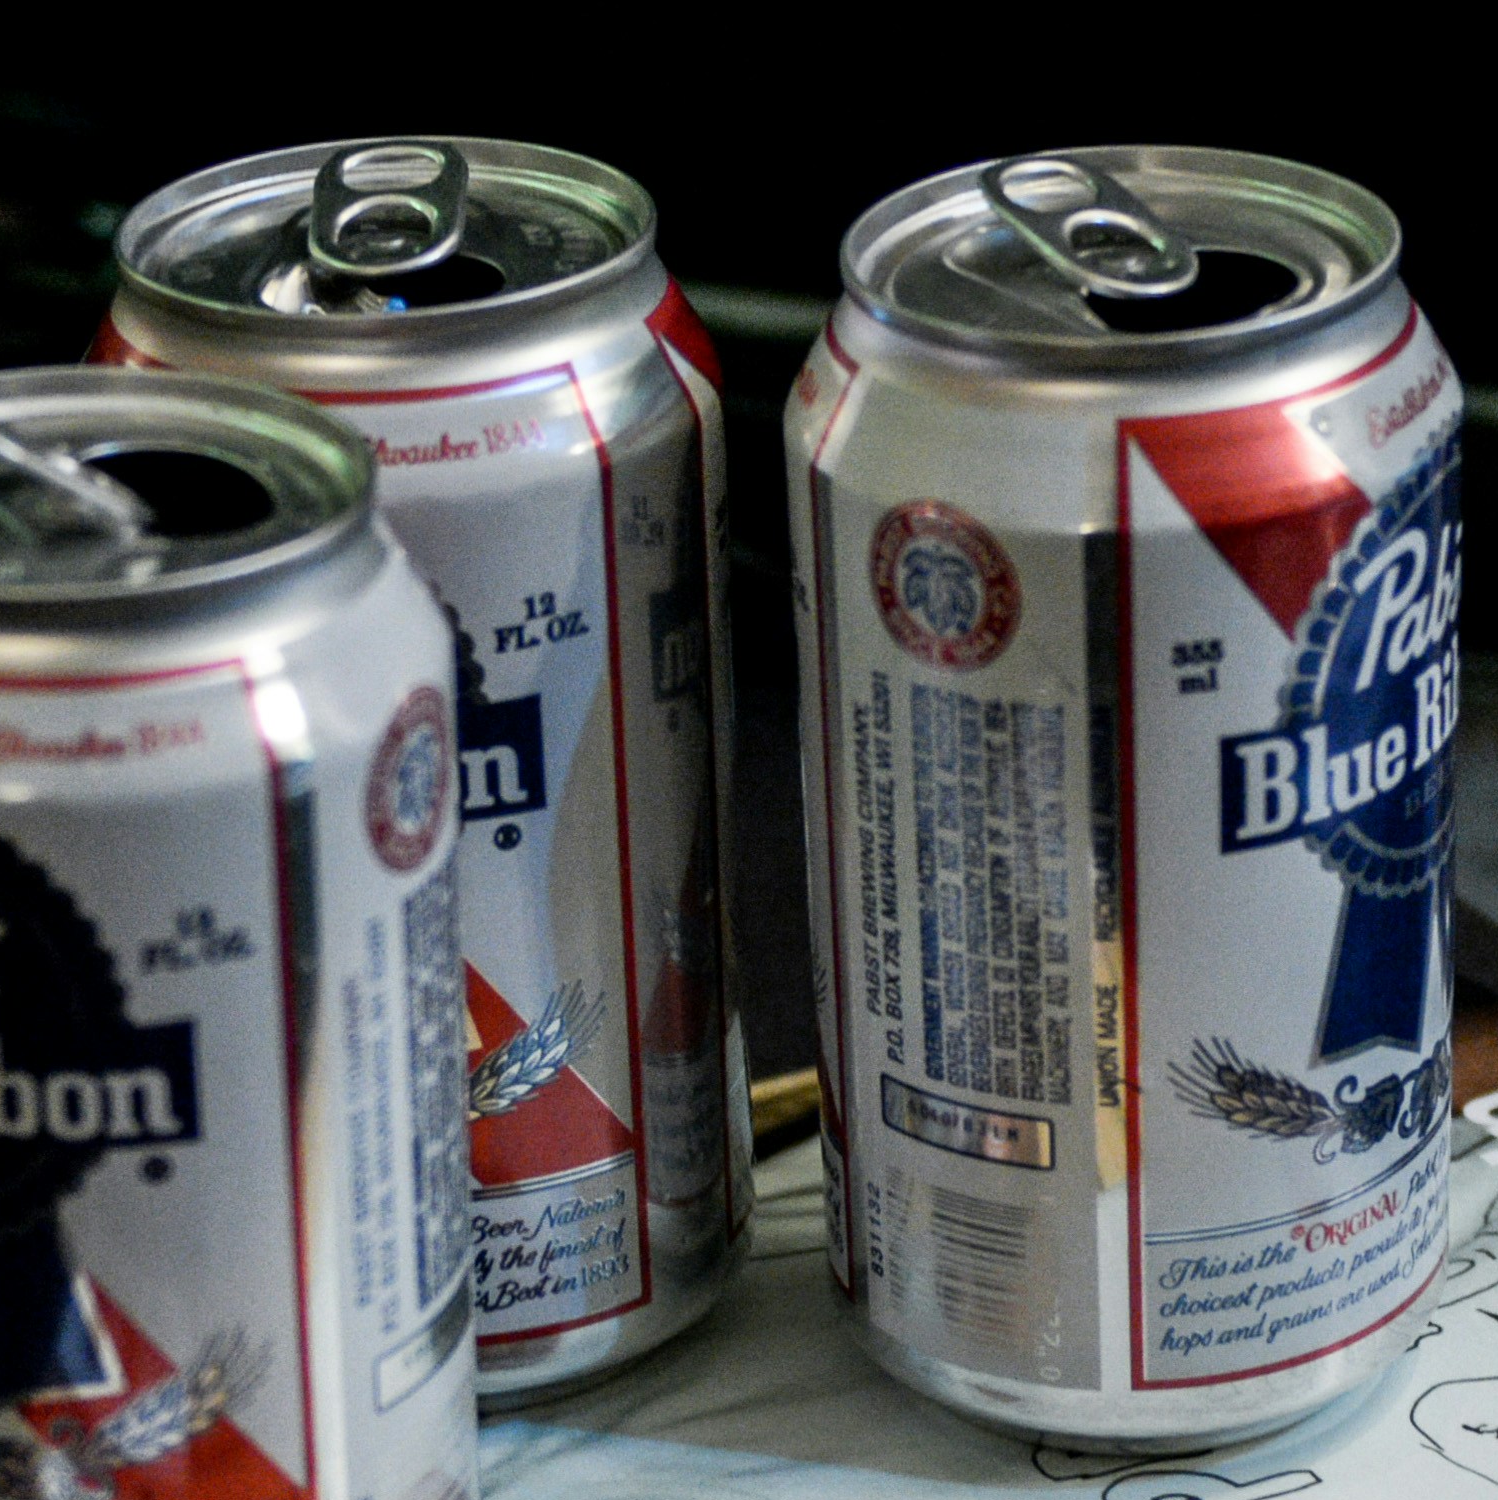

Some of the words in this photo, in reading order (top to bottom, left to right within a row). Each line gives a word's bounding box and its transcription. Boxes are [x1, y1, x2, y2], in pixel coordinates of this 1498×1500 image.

[524, 592, 557, 620] 12
[1234, 722, 1407, 842] Blue
[884, 973, 903, 1021] BOX
[1097, 983, 1119, 1040] MADE
[1097, 1045, 1121, 1106] UNION
[1159, 1257, 1227, 1290] This
[1256, 1241, 1297, 1270] the
[1160, 1282, 1258, 1318] choicest
[1256, 1257, 1346, 1313] products
[1159, 1326, 1215, 1356] hops
[1216, 1312, 1267, 1344] and
[1266, 1300, 1333, 1344] grains
